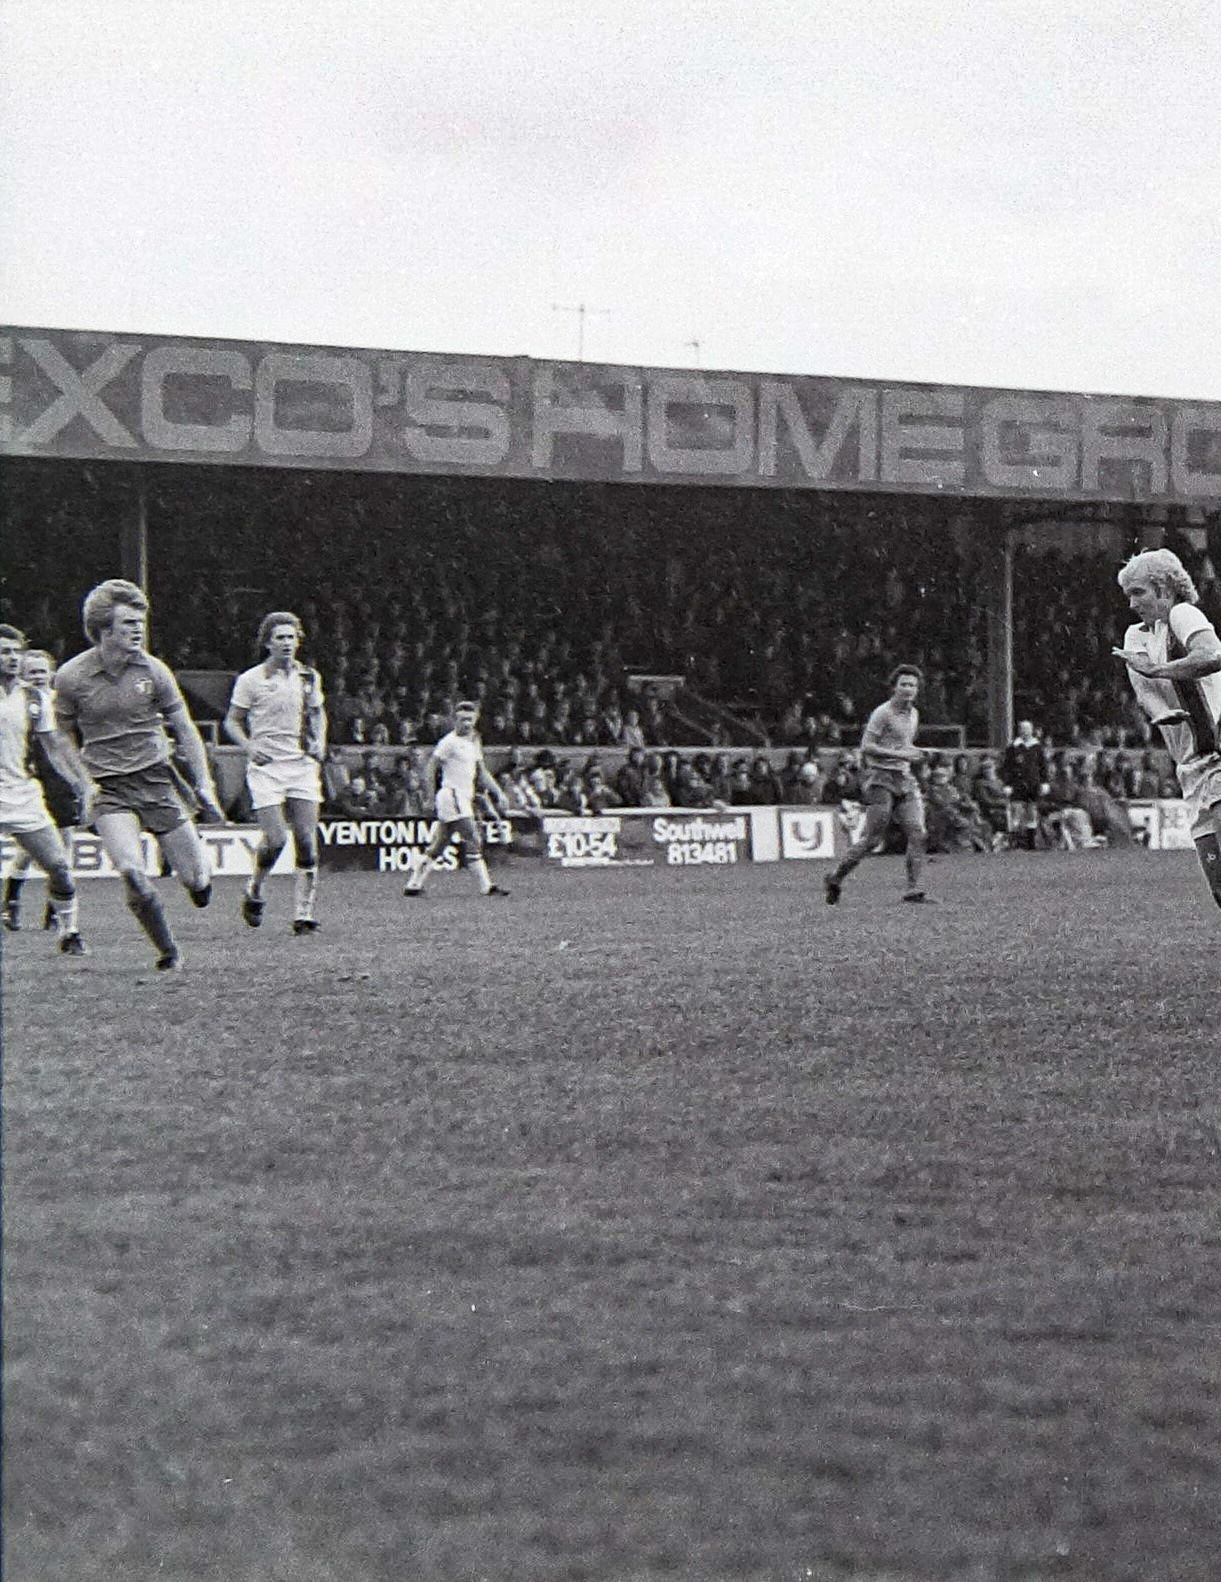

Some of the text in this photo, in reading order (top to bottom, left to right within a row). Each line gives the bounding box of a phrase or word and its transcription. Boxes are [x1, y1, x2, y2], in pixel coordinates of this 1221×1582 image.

[0, 337, 511, 465] XCO'S
[318, 820, 414, 844] YENTON
[653, 816, 746, 842] Southwell
[666, 842, 737, 865] 813481
